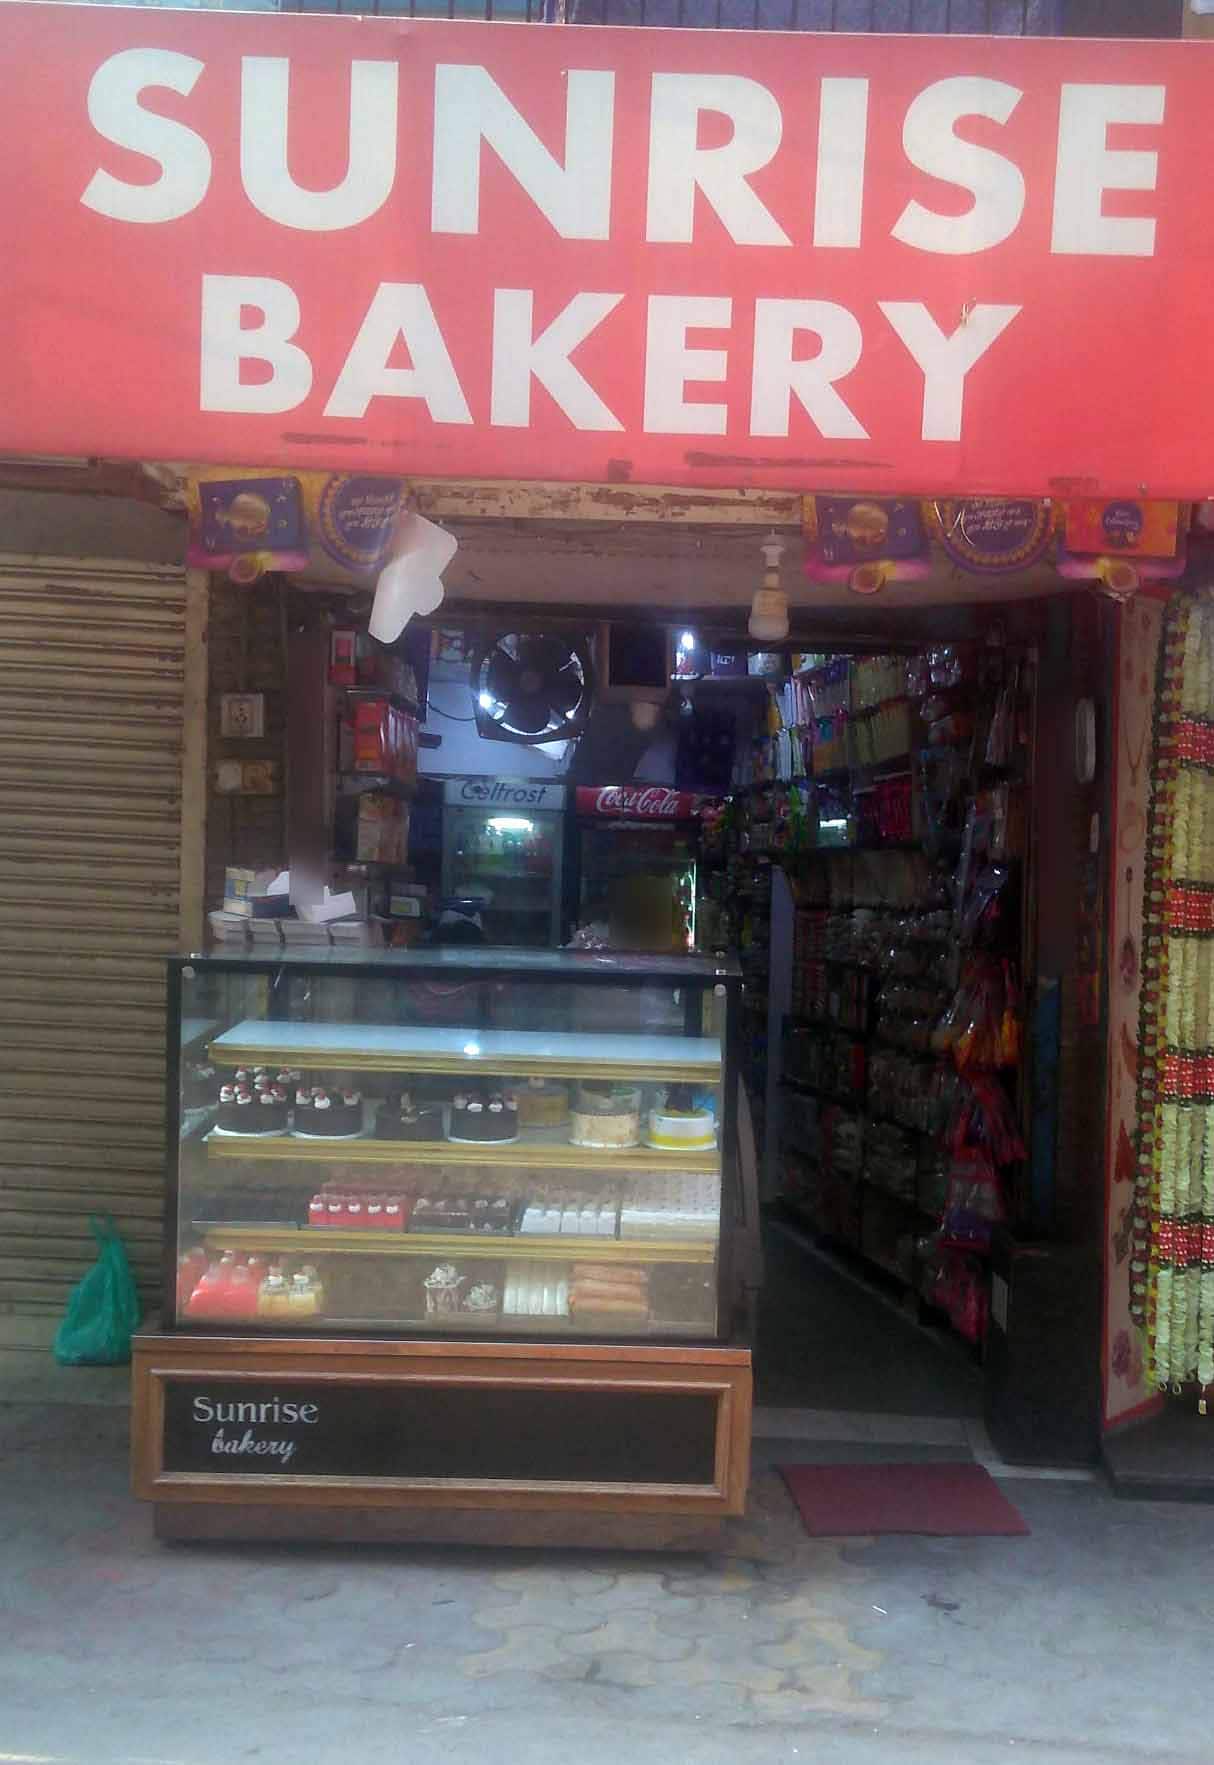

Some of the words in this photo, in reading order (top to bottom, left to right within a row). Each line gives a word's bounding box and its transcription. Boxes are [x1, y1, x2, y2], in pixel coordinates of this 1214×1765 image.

[80, 48, 1166, 257] SUNRISE
[199, 273, 1023, 442] BAKERY
[192, 1396, 320, 1424] Sunrise
[211, 1428, 296, 1464] bakery
